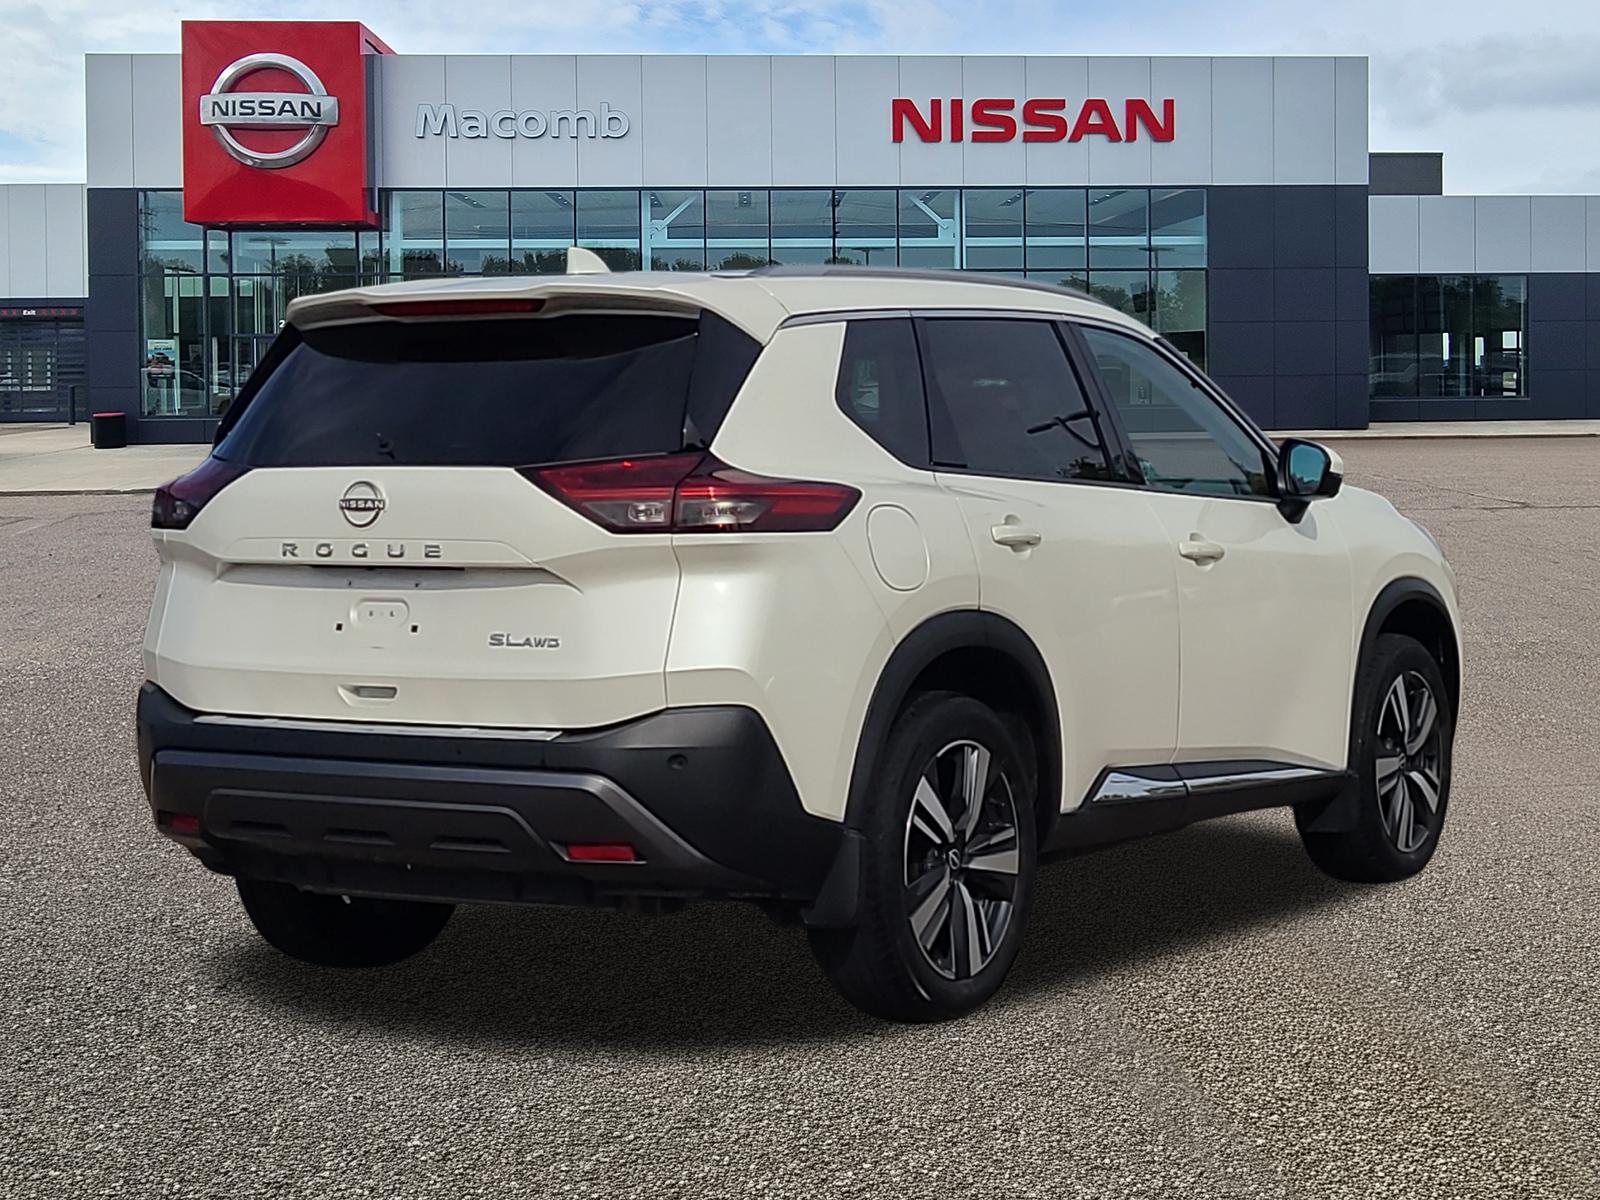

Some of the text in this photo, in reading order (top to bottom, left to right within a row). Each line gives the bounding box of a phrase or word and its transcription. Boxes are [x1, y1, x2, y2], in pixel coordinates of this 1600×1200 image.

[212, 100, 321, 117] NISSAN
[415, 102, 630, 139] Macomb
[892, 98, 1176, 142] NISSAN
[339, 500, 384, 509] NISSAN
[281, 542, 442, 558] ROGUE
